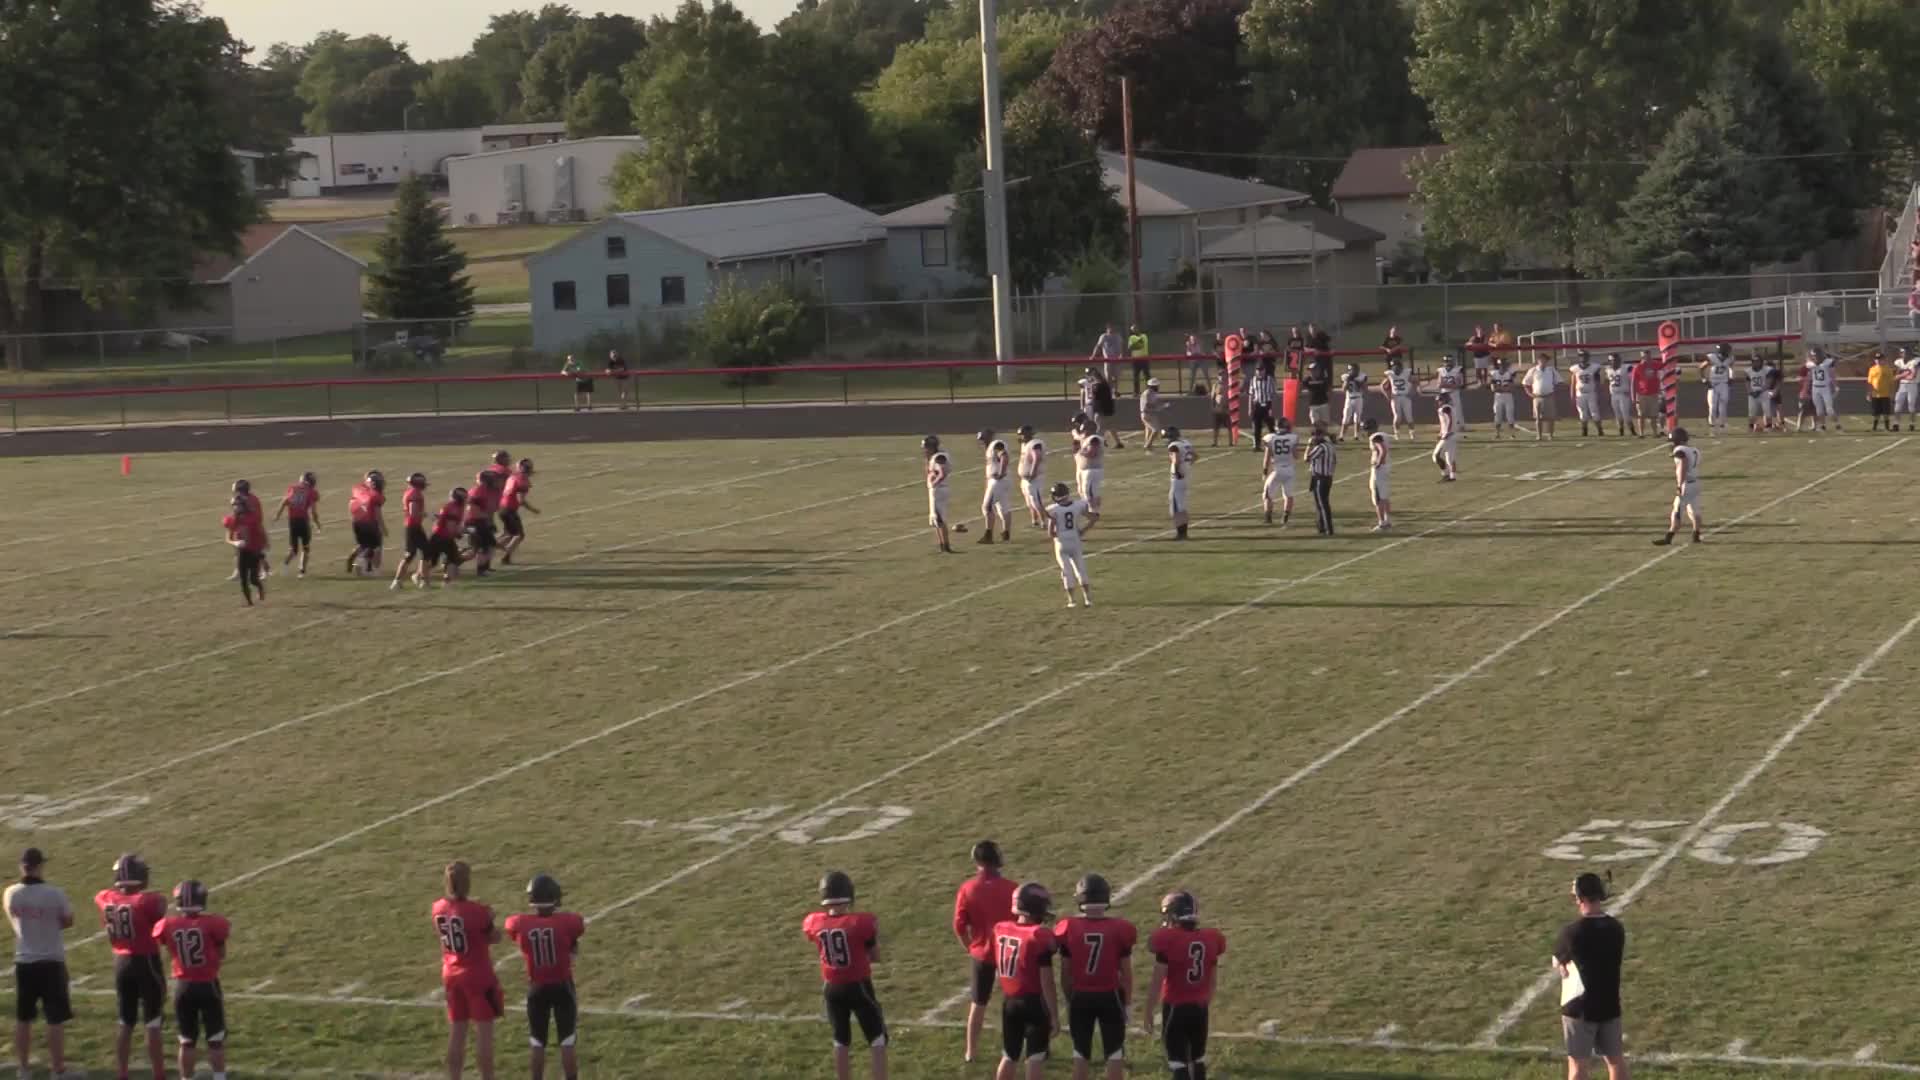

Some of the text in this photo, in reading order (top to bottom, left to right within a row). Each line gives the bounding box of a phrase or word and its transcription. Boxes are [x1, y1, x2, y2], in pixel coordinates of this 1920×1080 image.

[1274, 439, 1290, 455] 65
[1064, 511, 1074, 530] 8
[1541, 819, 1827, 864] 50
[104, 903, 134, 940] 58
[435, 915, 468, 954] 56
[172, 926, 206, 969] 12
[528, 927, 556, 968] 11
[819, 928, 849, 968] 19
[996, 935, 1022, 978] 17
[1084, 932, 1104, 975] 7
[1187, 941, 1205, 984] 3
